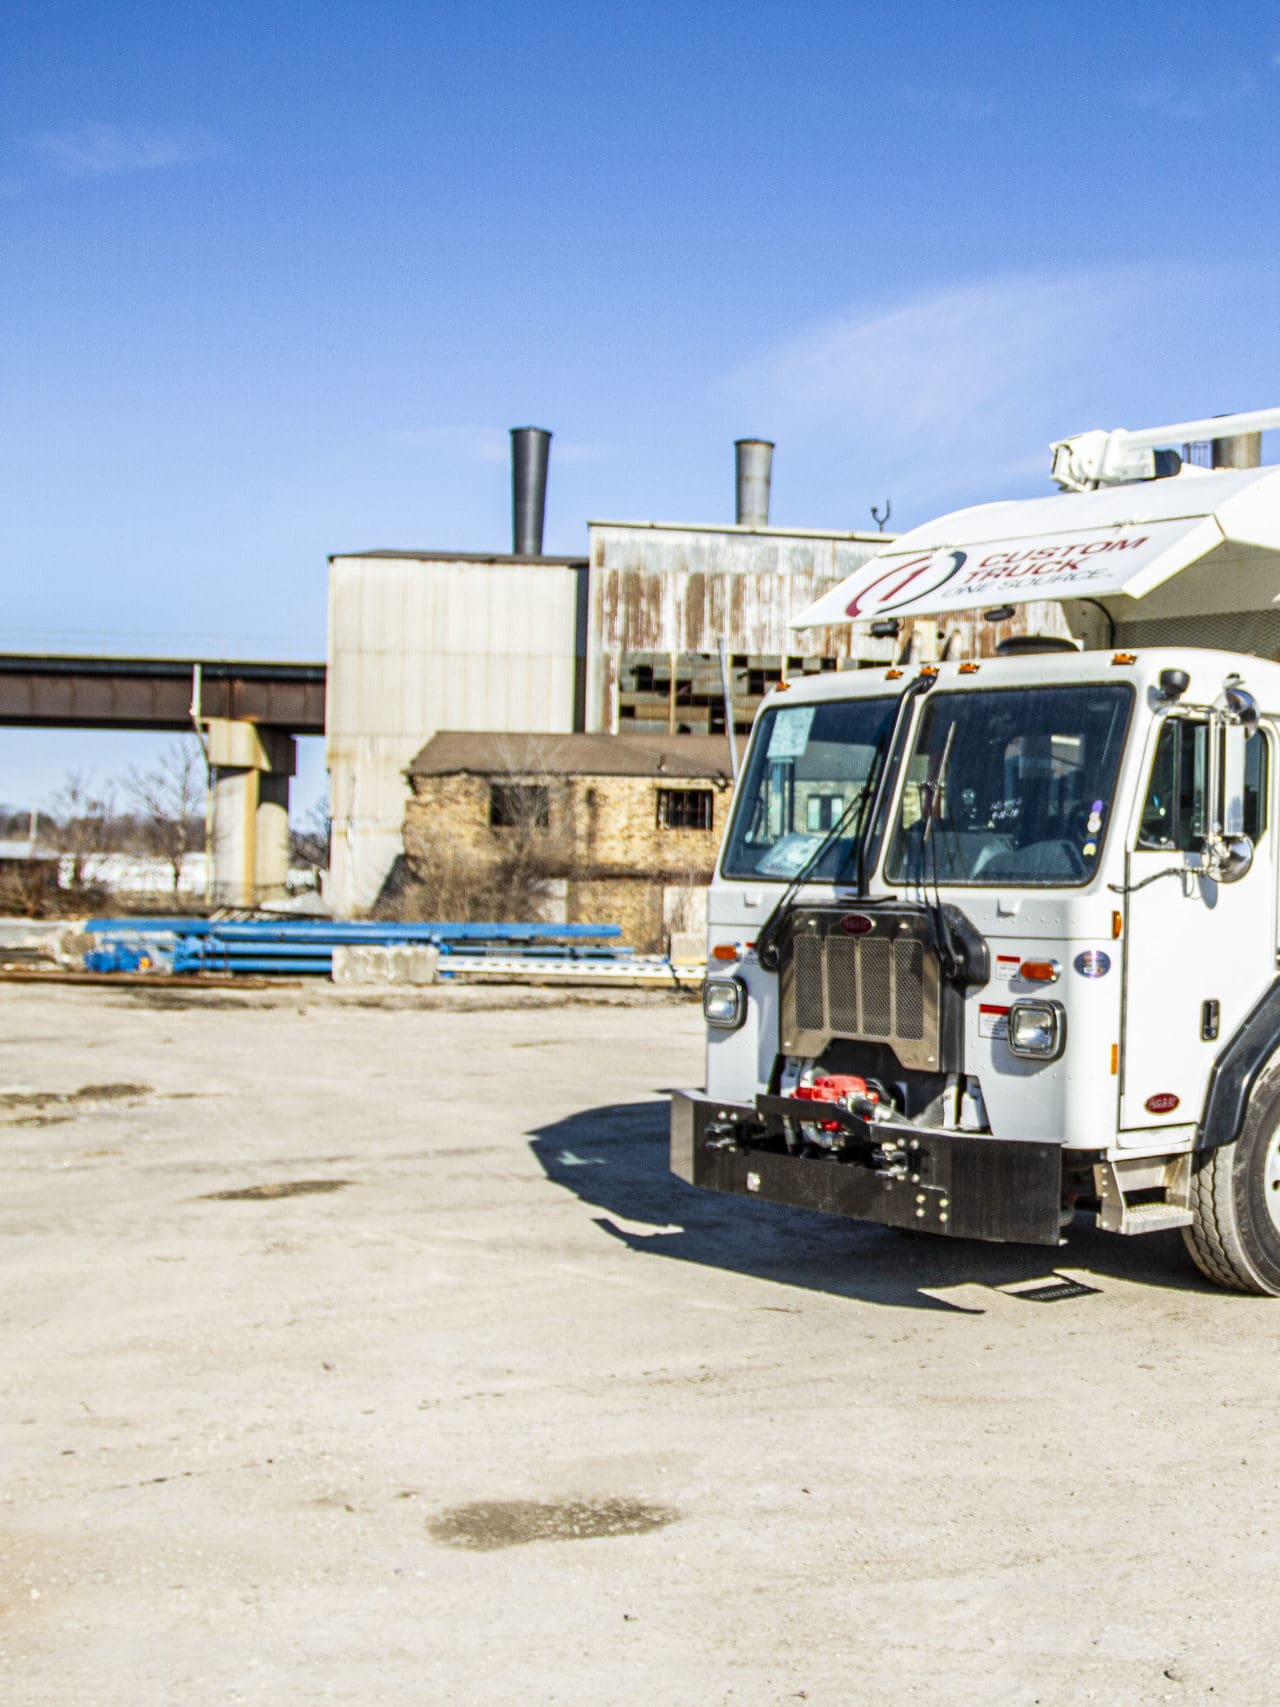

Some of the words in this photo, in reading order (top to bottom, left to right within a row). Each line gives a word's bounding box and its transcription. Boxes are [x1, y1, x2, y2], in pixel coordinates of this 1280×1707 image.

[978, 535, 1150, 569] CUSTOM
[941, 578, 995, 598] ONE
[996, 567, 1107, 591] SOURCE
[963, 556, 1091, 585] TRUCK
